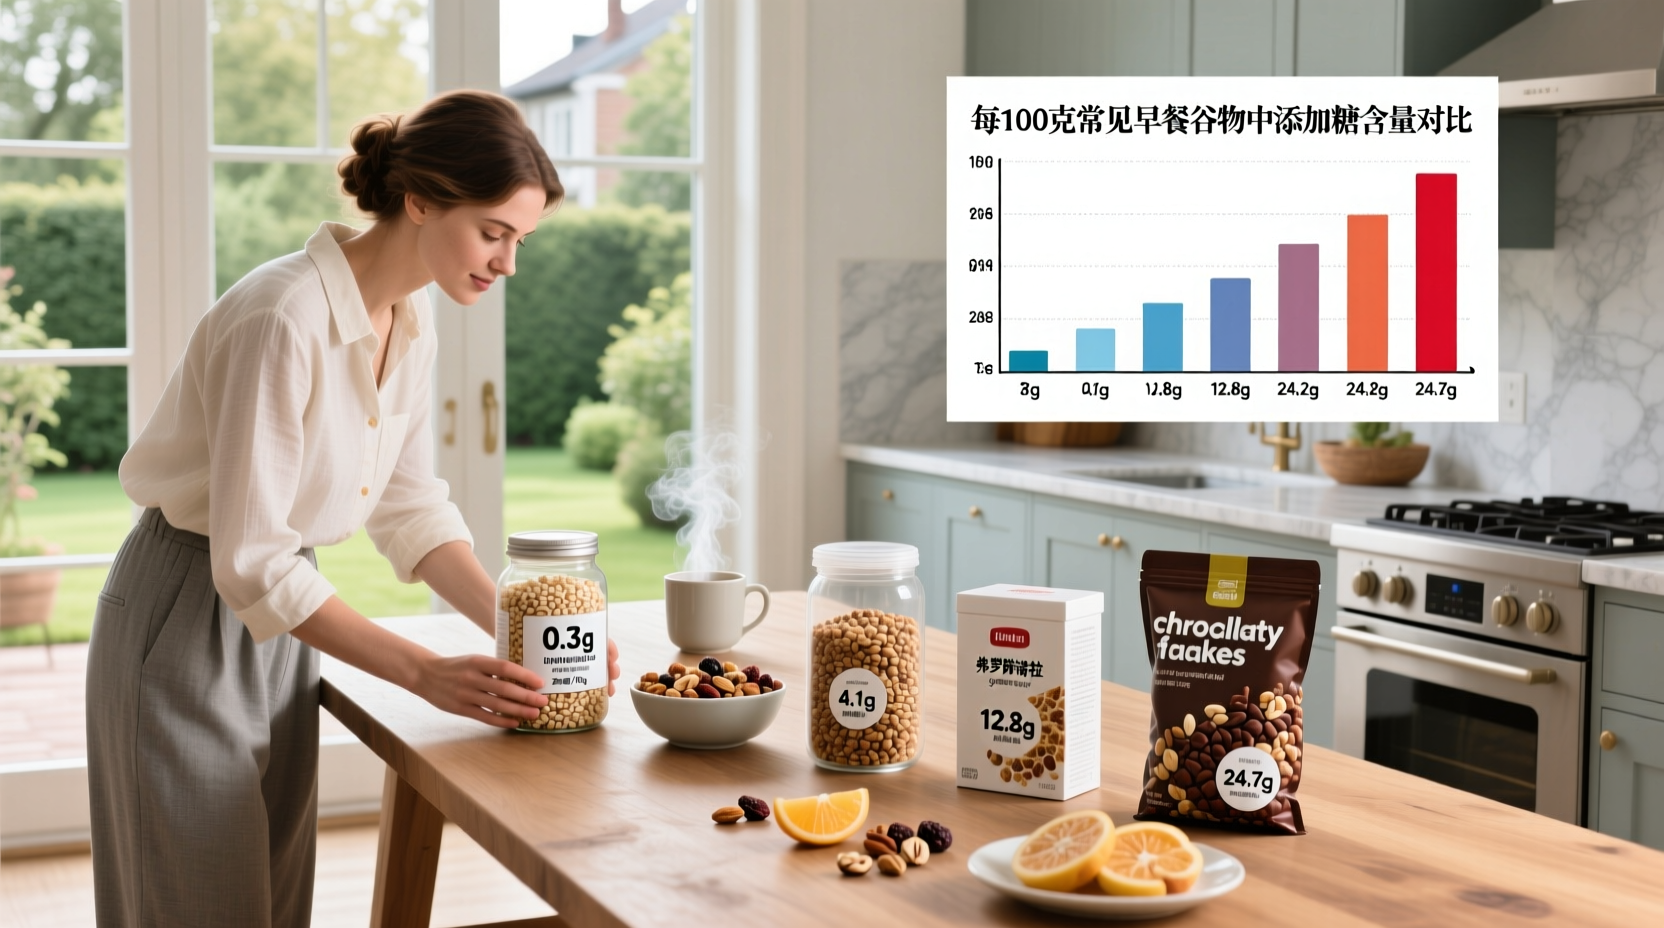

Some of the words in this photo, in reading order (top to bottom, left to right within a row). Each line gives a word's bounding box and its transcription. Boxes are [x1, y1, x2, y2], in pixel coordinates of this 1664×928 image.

[543, 626, 593, 653] 0.3g
[838, 689, 876, 712] 4.1g
[980, 708, 1035, 740] 12.8g
[1223, 769, 1273, 794] 24.7g
